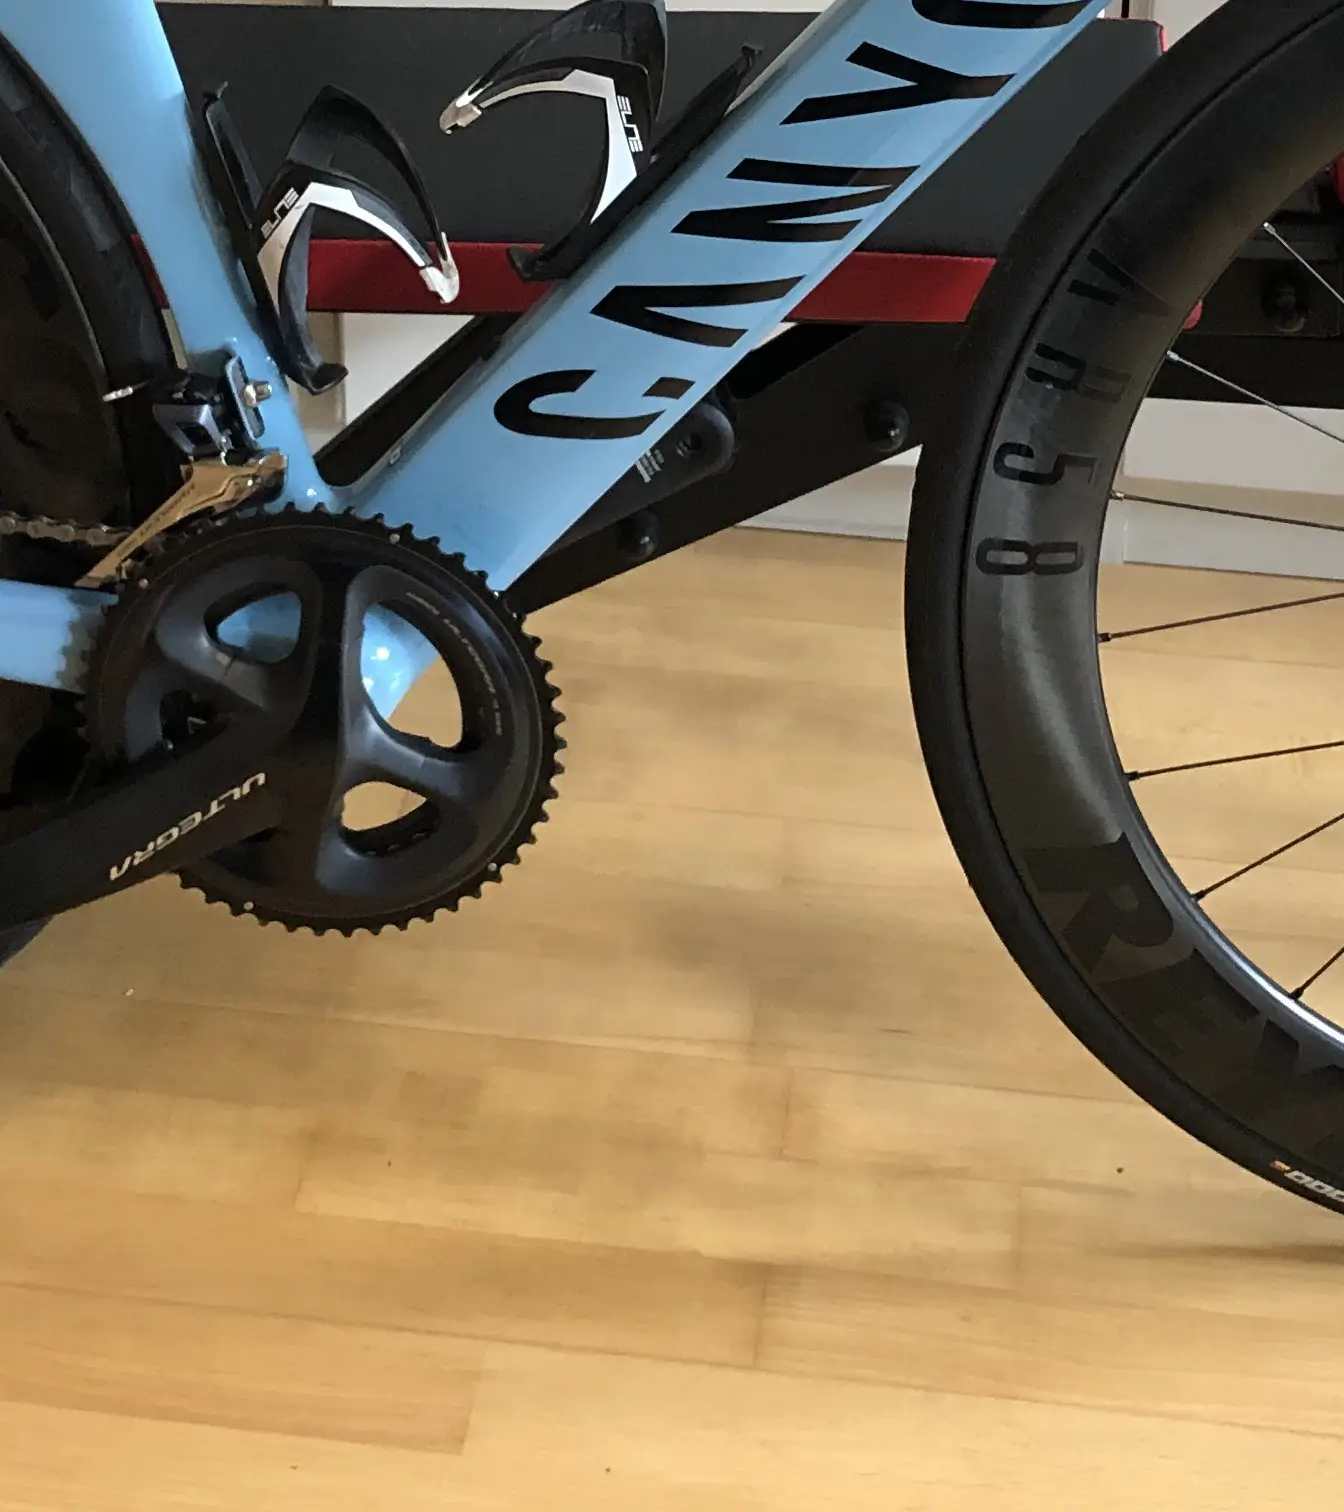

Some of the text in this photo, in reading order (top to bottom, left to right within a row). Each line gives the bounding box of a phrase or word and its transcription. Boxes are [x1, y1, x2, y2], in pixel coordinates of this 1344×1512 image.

[616, 94, 644, 153] ELITE
[261, 187, 299, 238] ELITE
[109, 771, 267, 881] ULTEGRA
